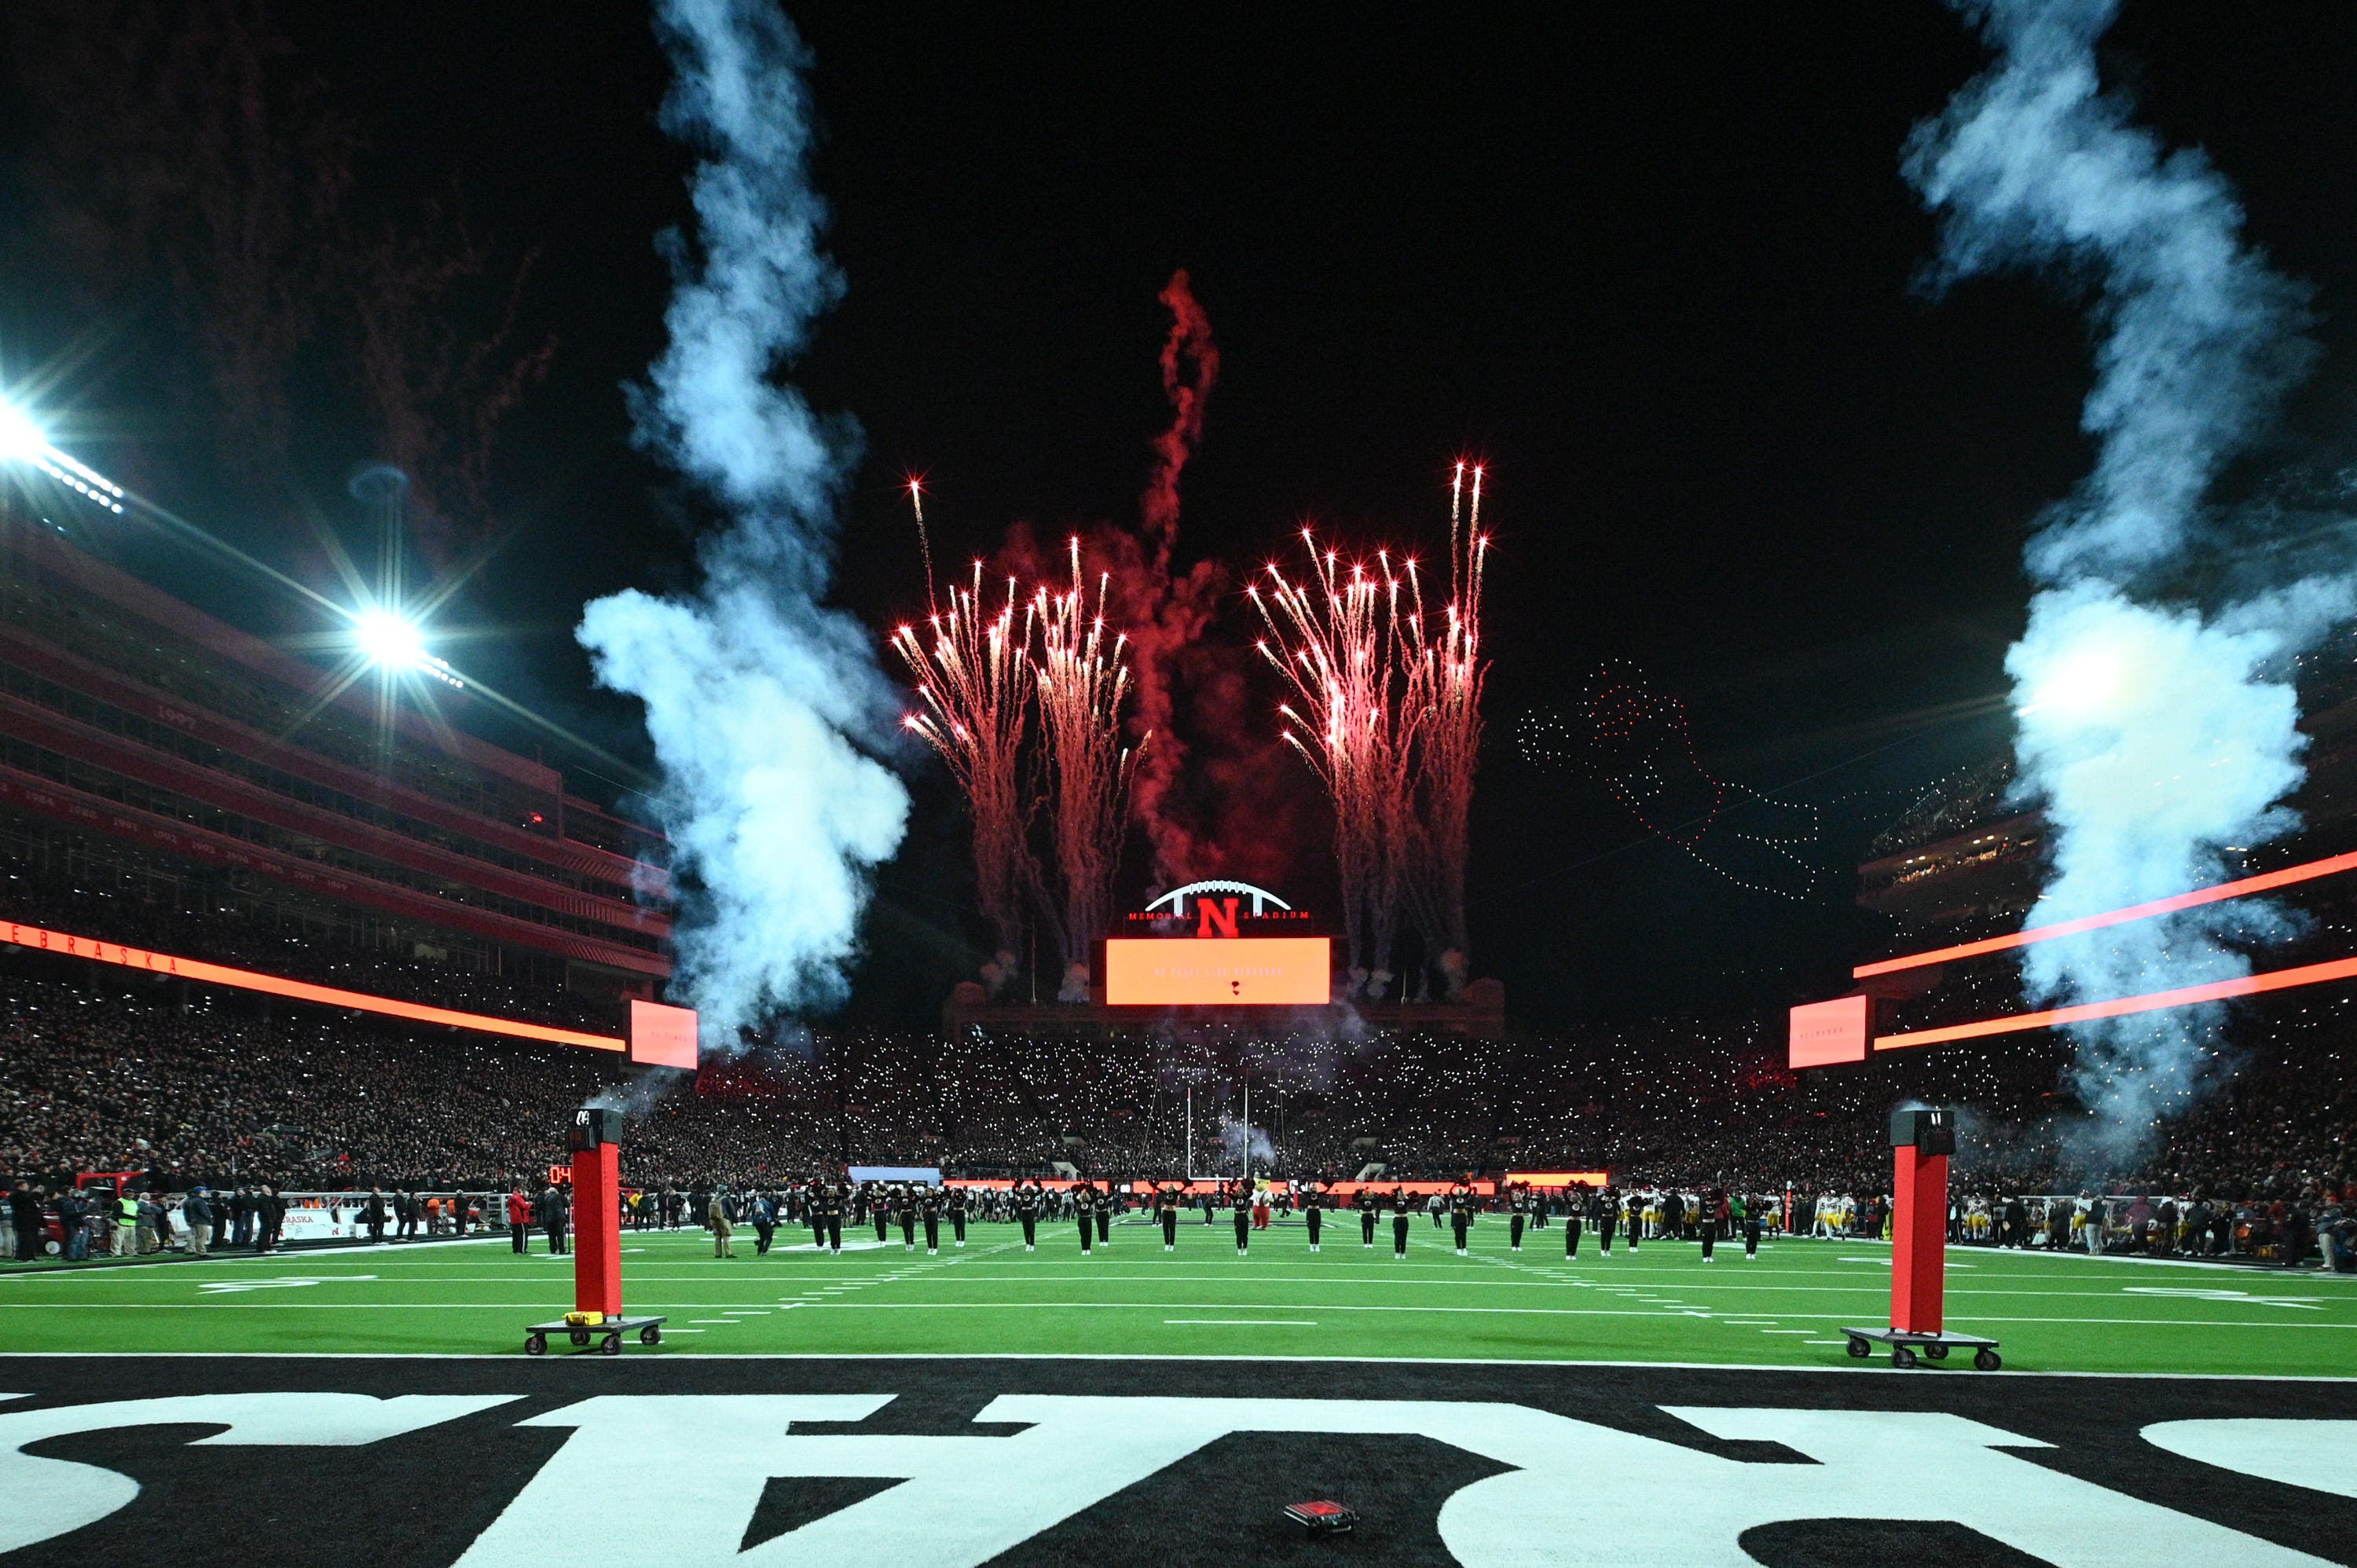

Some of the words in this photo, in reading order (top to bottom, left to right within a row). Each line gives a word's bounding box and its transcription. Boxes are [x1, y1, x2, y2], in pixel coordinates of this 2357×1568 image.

[158, 705, 196, 729] 1997
[1197, 898, 1238, 937] N
[12, 925, 177, 975] EBRASKA
